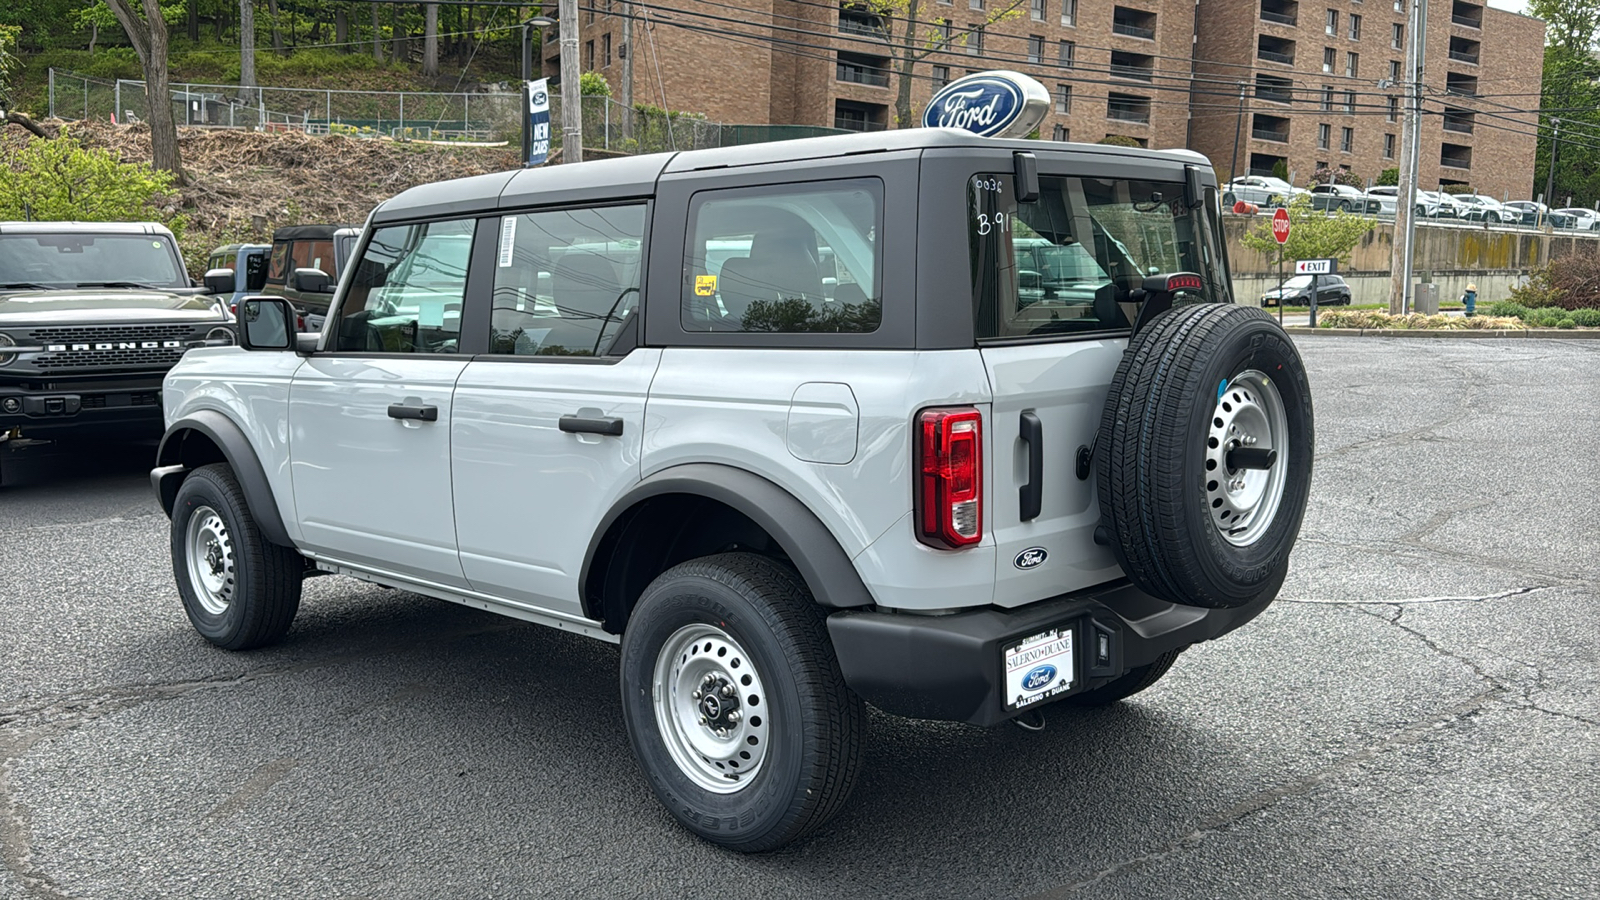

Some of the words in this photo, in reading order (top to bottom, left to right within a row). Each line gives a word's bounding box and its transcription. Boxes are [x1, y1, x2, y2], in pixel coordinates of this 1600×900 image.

[939, 88, 1000, 128] Ford
[533, 122, 549, 140] NEW
[533, 140, 549, 155] CARS
[976, 178, 1002, 194] 0036
[1274, 219, 1289, 233] STOP
[1307, 262, 1326, 271] EXIT
[48, 341, 180, 351] BRONCO
[1021, 551, 1043, 567] Ford
[1007, 649, 1041, 669] SALERNO
[1044, 639, 1070, 656] DUANE
[1028, 669, 1050, 687] Ford
[1015, 693, 1044, 709] SALERNO
[1051, 683, 1071, 696] DUANE
